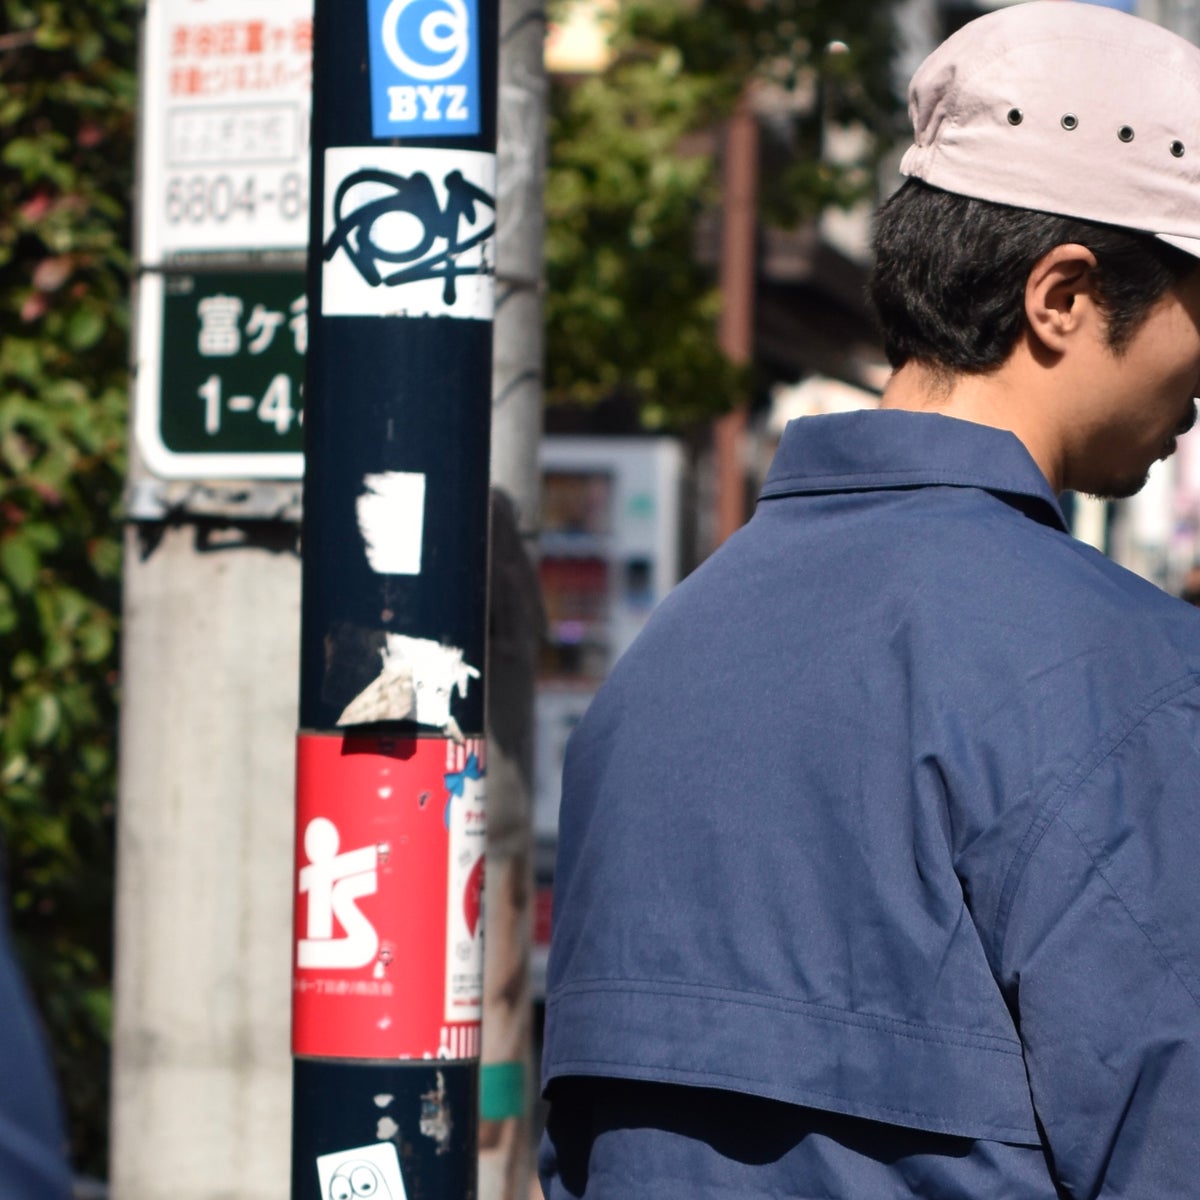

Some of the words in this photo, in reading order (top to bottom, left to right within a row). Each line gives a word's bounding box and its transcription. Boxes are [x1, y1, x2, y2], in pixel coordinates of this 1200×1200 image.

[387, 85, 469, 121] BYZ
[165, 172, 308, 229] 6804-8
[198, 374, 305, 435] 1-4
